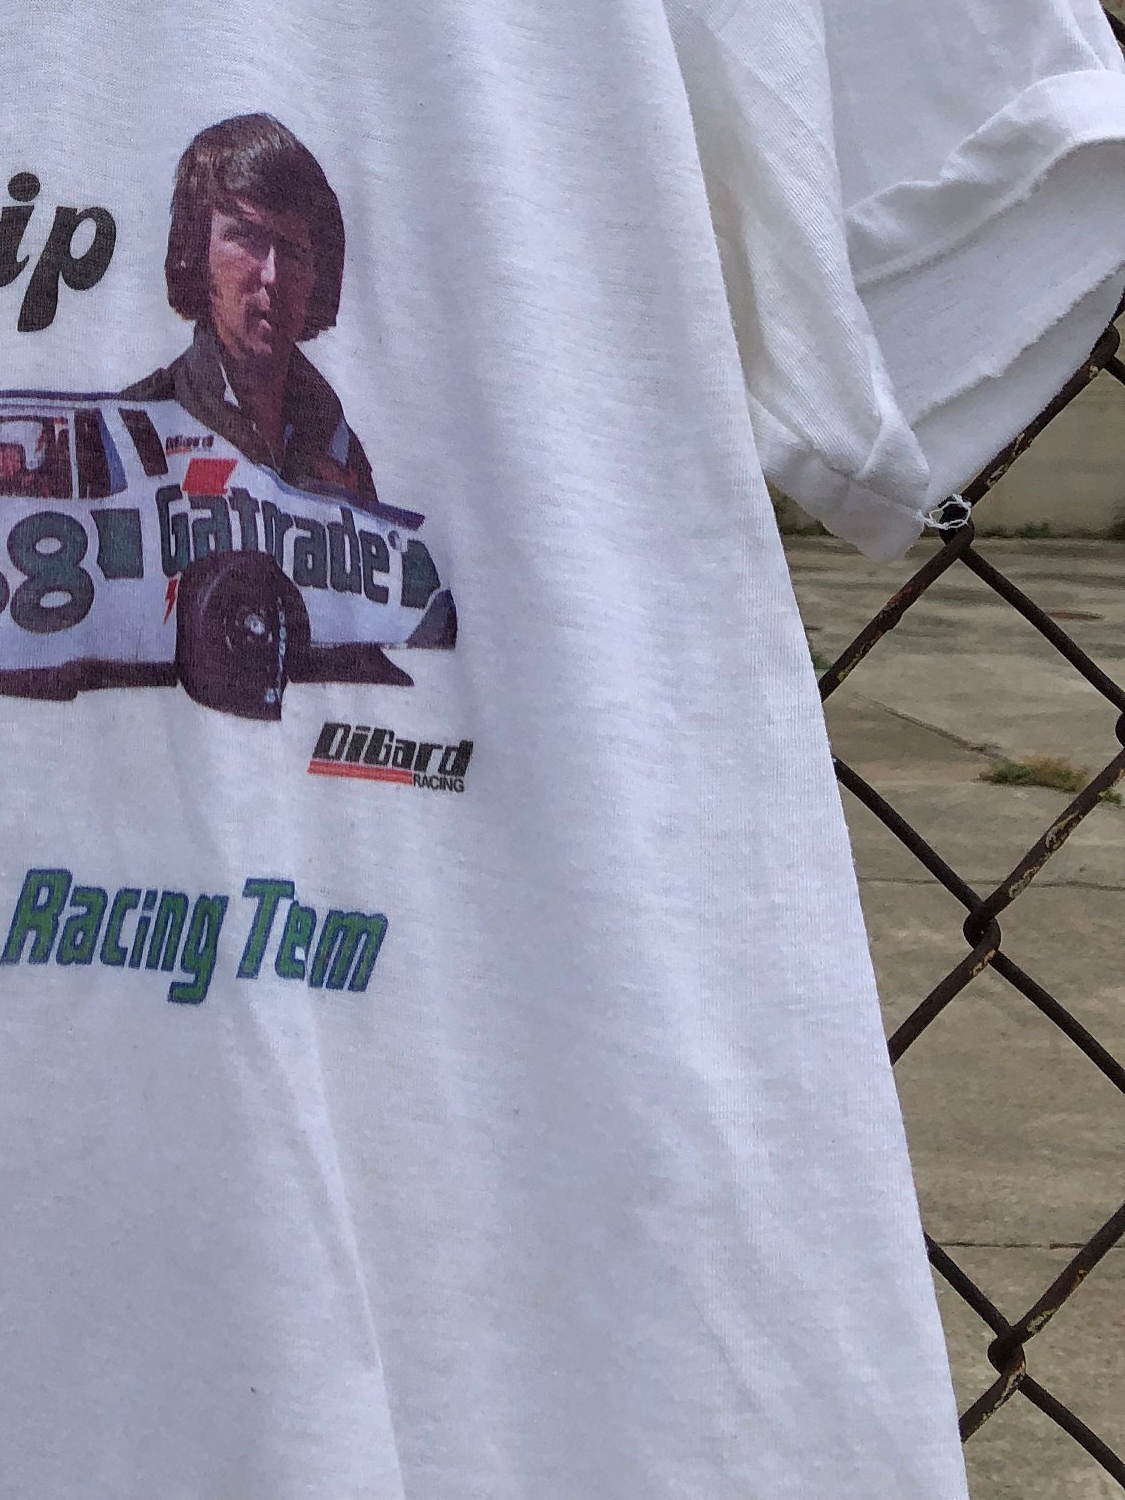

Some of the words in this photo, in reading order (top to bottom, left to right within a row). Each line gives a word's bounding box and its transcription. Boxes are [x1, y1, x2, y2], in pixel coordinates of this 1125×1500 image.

[312, 720, 474, 778] DiGard
[412, 774, 465, 794] RACING
[0, 867, 227, 1005] Racing
